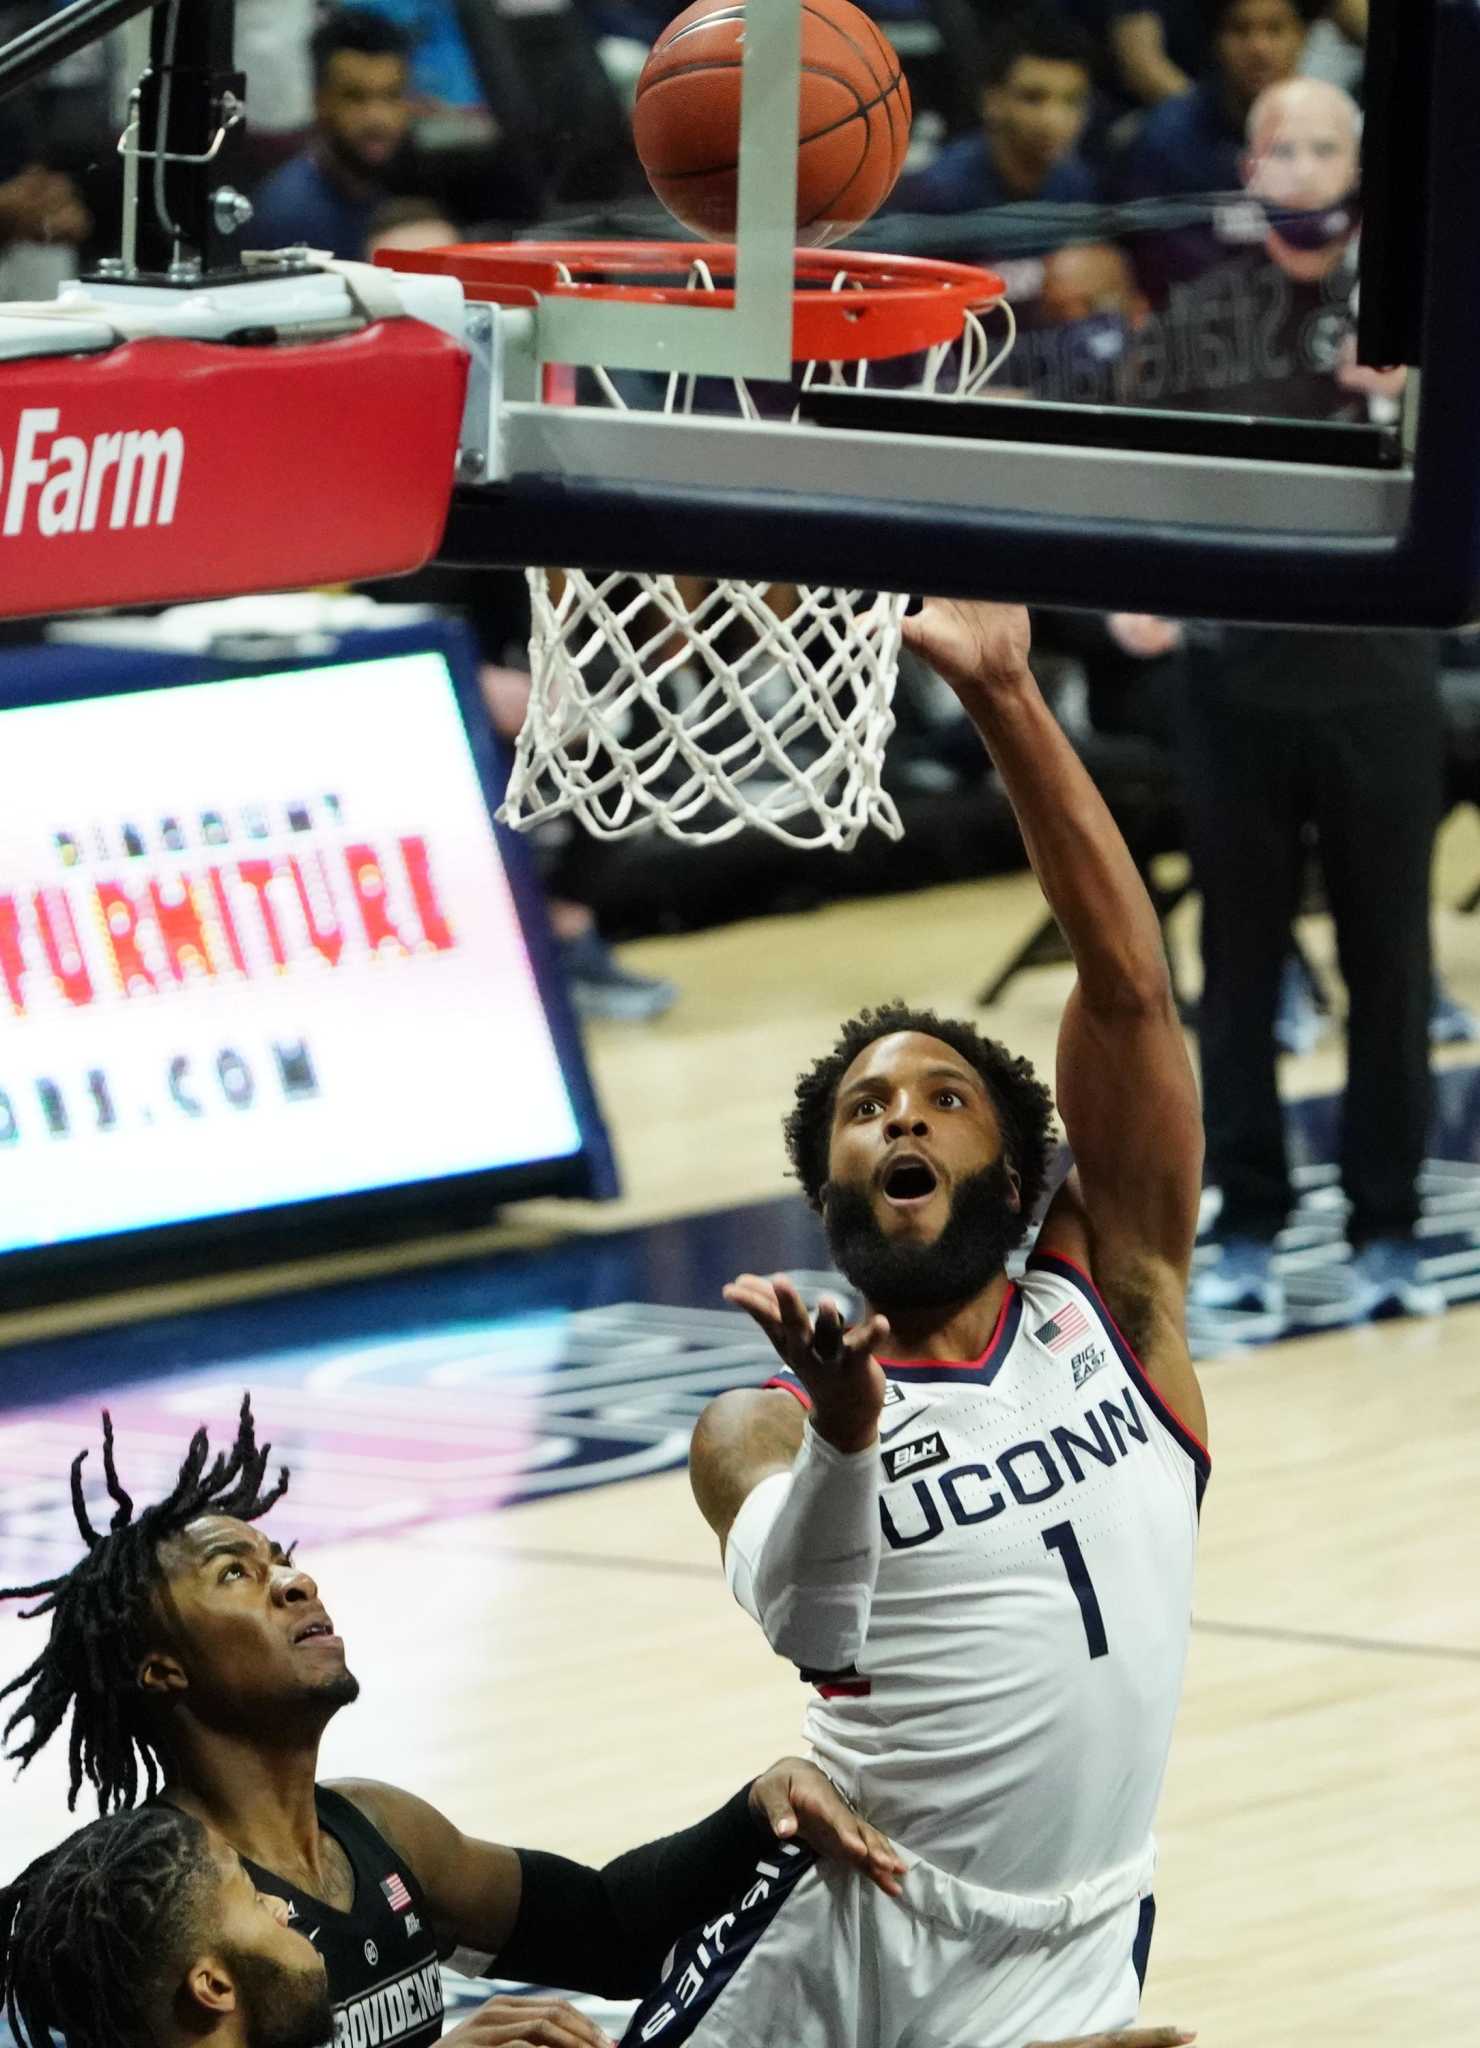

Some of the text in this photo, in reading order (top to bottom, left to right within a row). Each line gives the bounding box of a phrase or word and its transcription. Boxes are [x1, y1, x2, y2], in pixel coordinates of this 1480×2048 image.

[1071, 1343, 1095, 1370] BIG
[1074, 1350, 1105, 1382] EAST
[879, 1387, 1149, 1549] UCONN
[894, 1437, 938, 1470] BLM
[1042, 1520, 1109, 1659] 1
[324, 1959, 442, 2048] ROVIDENC
